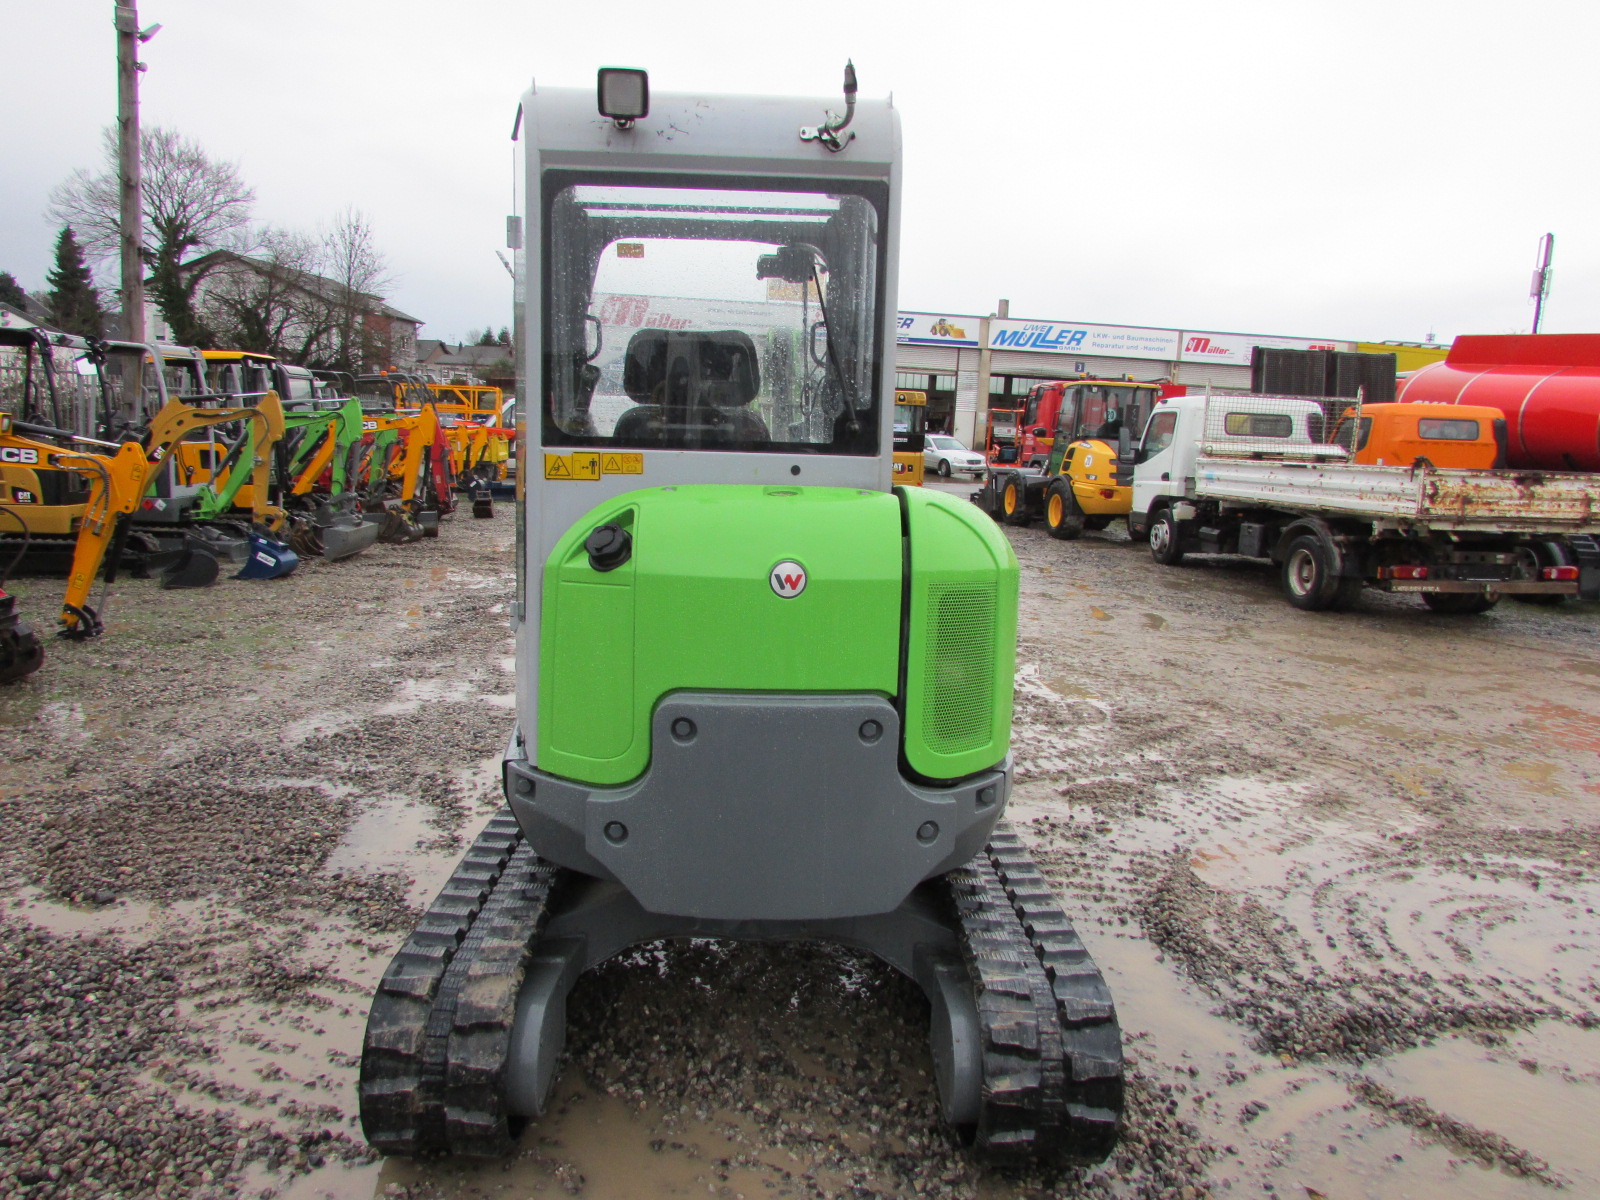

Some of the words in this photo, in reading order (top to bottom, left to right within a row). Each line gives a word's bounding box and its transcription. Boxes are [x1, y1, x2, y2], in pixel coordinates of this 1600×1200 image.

[1023, 323, 1048, 332] UWE
[991, 326, 1088, 349] MÜLLER
[1092, 342, 1124, 350] Reparatur
[1184, 337, 1230, 355] Müller
[1077, 363, 1083, 371] 3
[0, 447, 38, 464] CB
[153, 445, 166, 459] CAT
[18, 491, 31, 500] CAT
